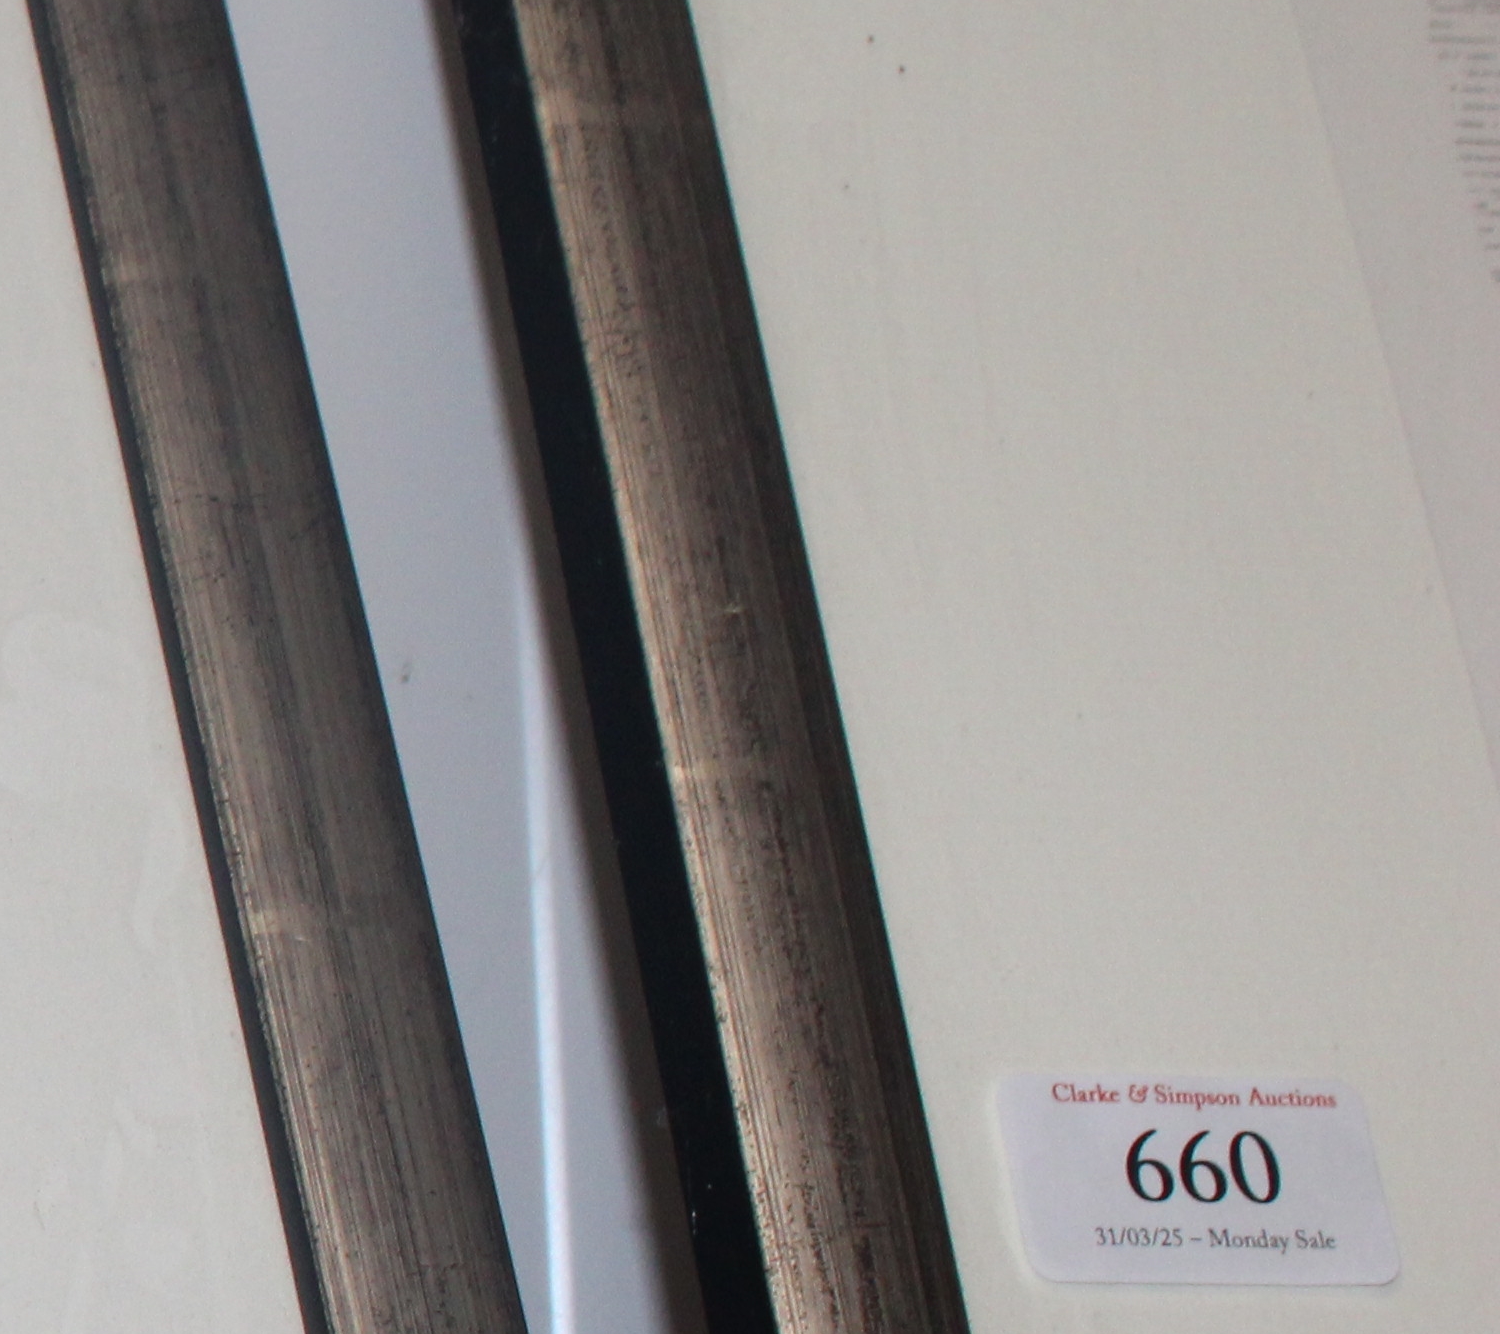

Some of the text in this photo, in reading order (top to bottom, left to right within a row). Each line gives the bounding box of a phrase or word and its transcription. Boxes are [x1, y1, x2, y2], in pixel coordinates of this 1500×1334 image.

[1051, 1083, 1337, 1111] Clarke & Simpson Auctions
[1125, 1128, 1282, 1204] 660
[1094, 1226, 1184, 1248] 31/03/25
[1208, 1229, 1290, 1255] Monday
[1294, 1230, 1337, 1250] Sale
